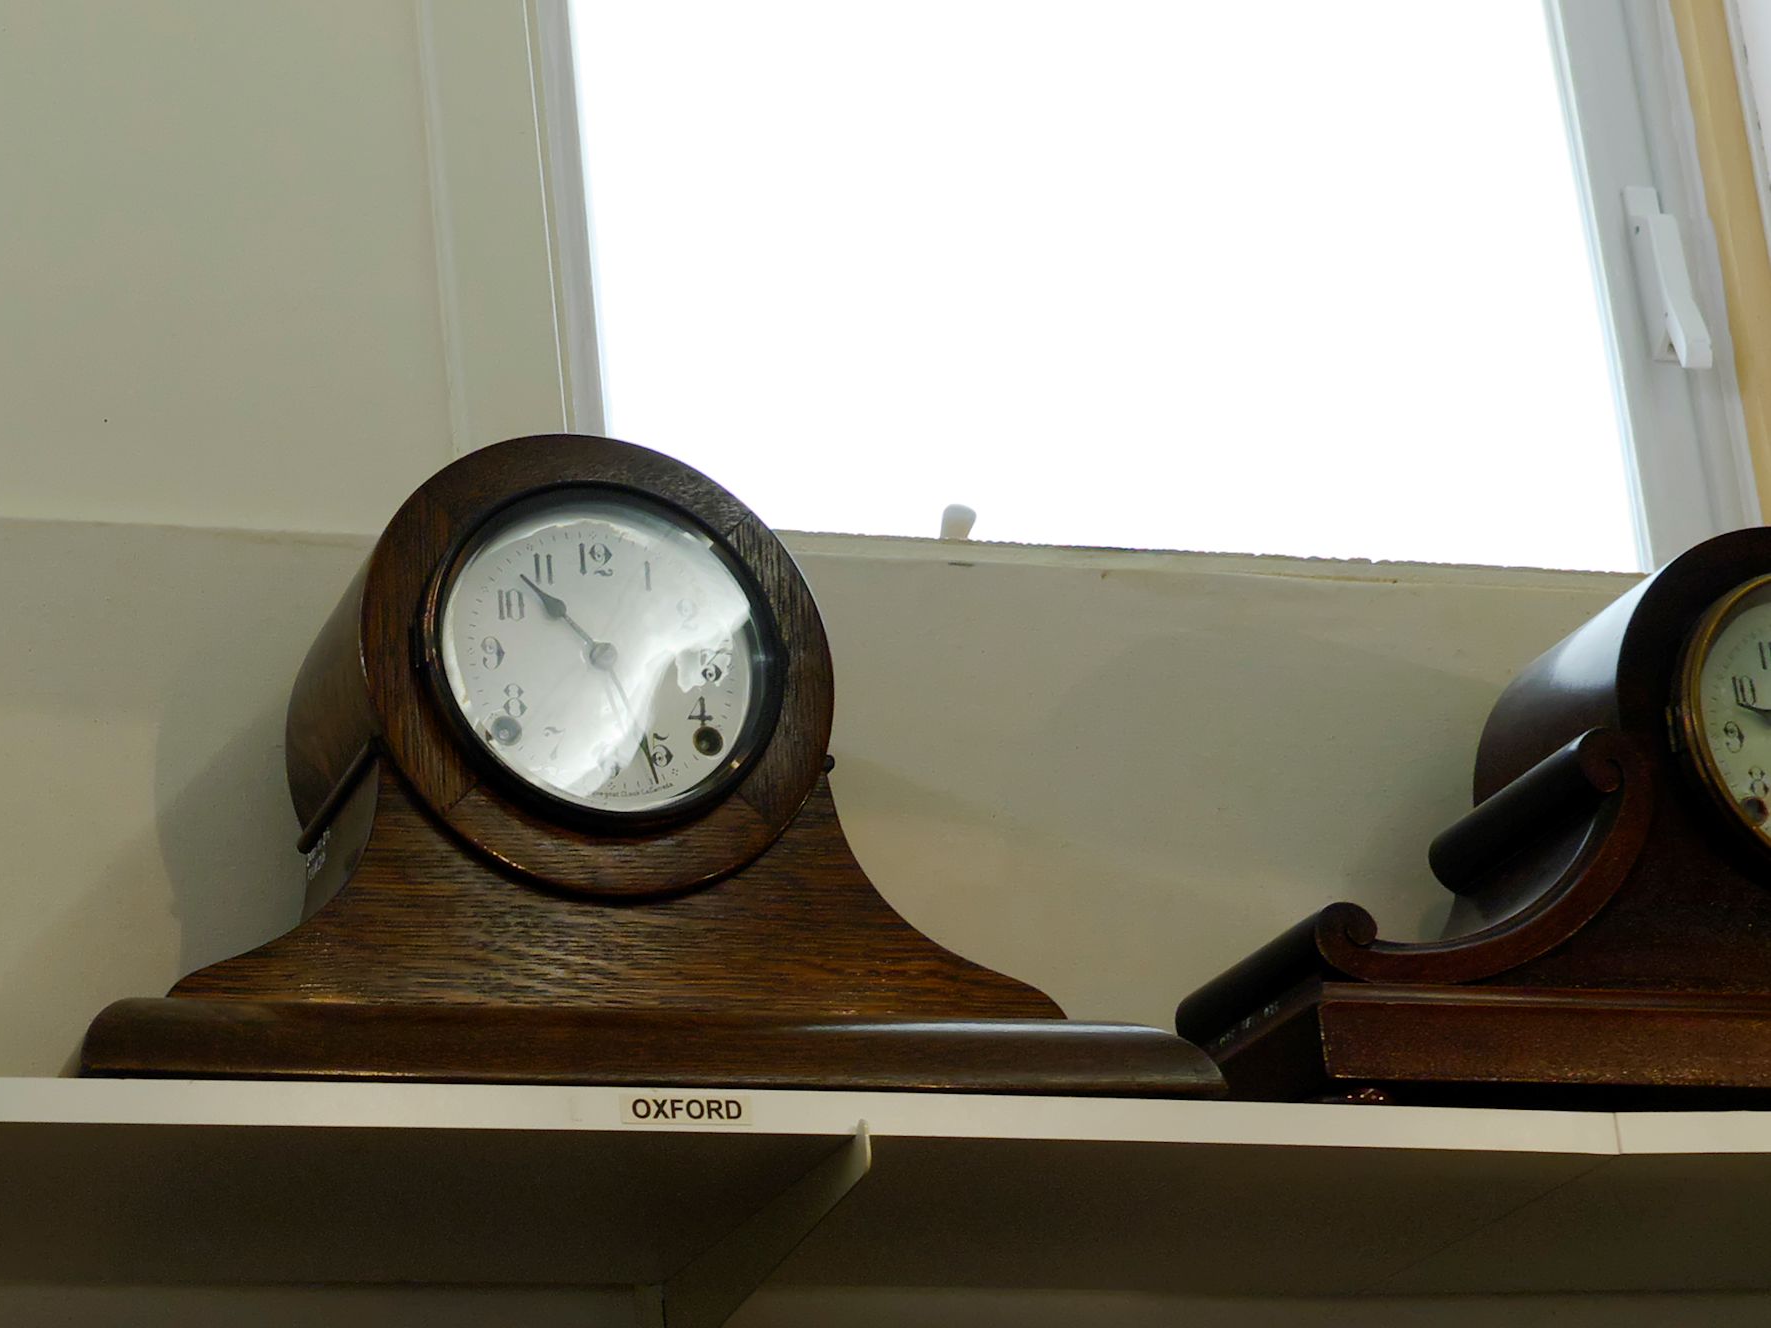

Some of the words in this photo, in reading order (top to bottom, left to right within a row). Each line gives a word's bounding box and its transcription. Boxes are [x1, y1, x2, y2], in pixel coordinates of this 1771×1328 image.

[534, 553, 553, 585] 11
[578, 542, 612, 577] 12
[643, 561, 652, 591] 1
[497, 587, 526, 621] 10
[480, 635, 505, 670] 9
[503, 683, 527, 718] 8
[1731, 675, 1756, 706] 10
[687, 696, 713, 725] 4
[543, 726, 566, 755] 7
[648, 732, 674, 767] 5
[1724, 720, 1745, 753] 9
[1748, 765, 1770, 797] 8
[632, 1098, 742, 1120] OXFORD
